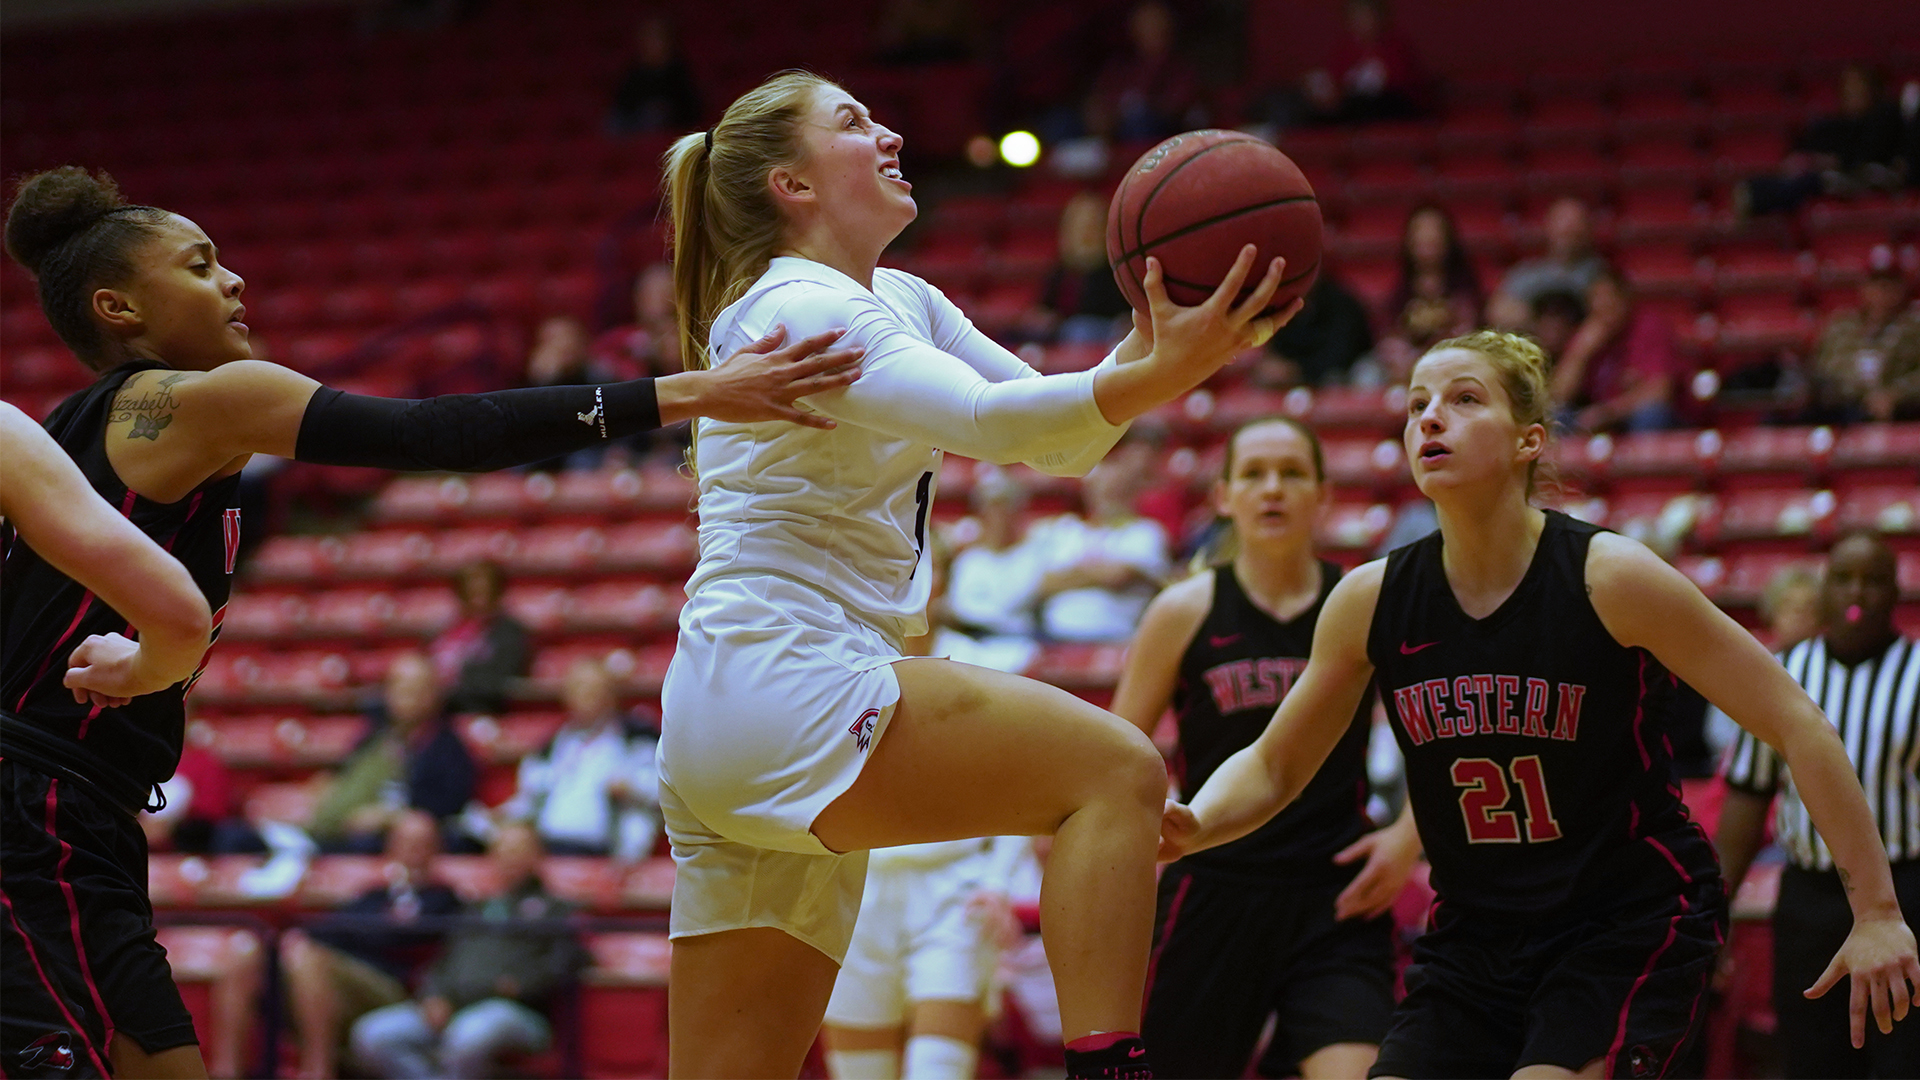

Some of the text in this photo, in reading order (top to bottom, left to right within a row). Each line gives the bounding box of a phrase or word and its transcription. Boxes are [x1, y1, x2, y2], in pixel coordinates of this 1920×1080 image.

[111, 386, 180, 410] lizabeth
[595, 386, 607, 438] MUELLER
[1202, 657, 1309, 715] WEST
[1393, 674, 1587, 746] WESTERN
[1450, 755, 1563, 844] 21
